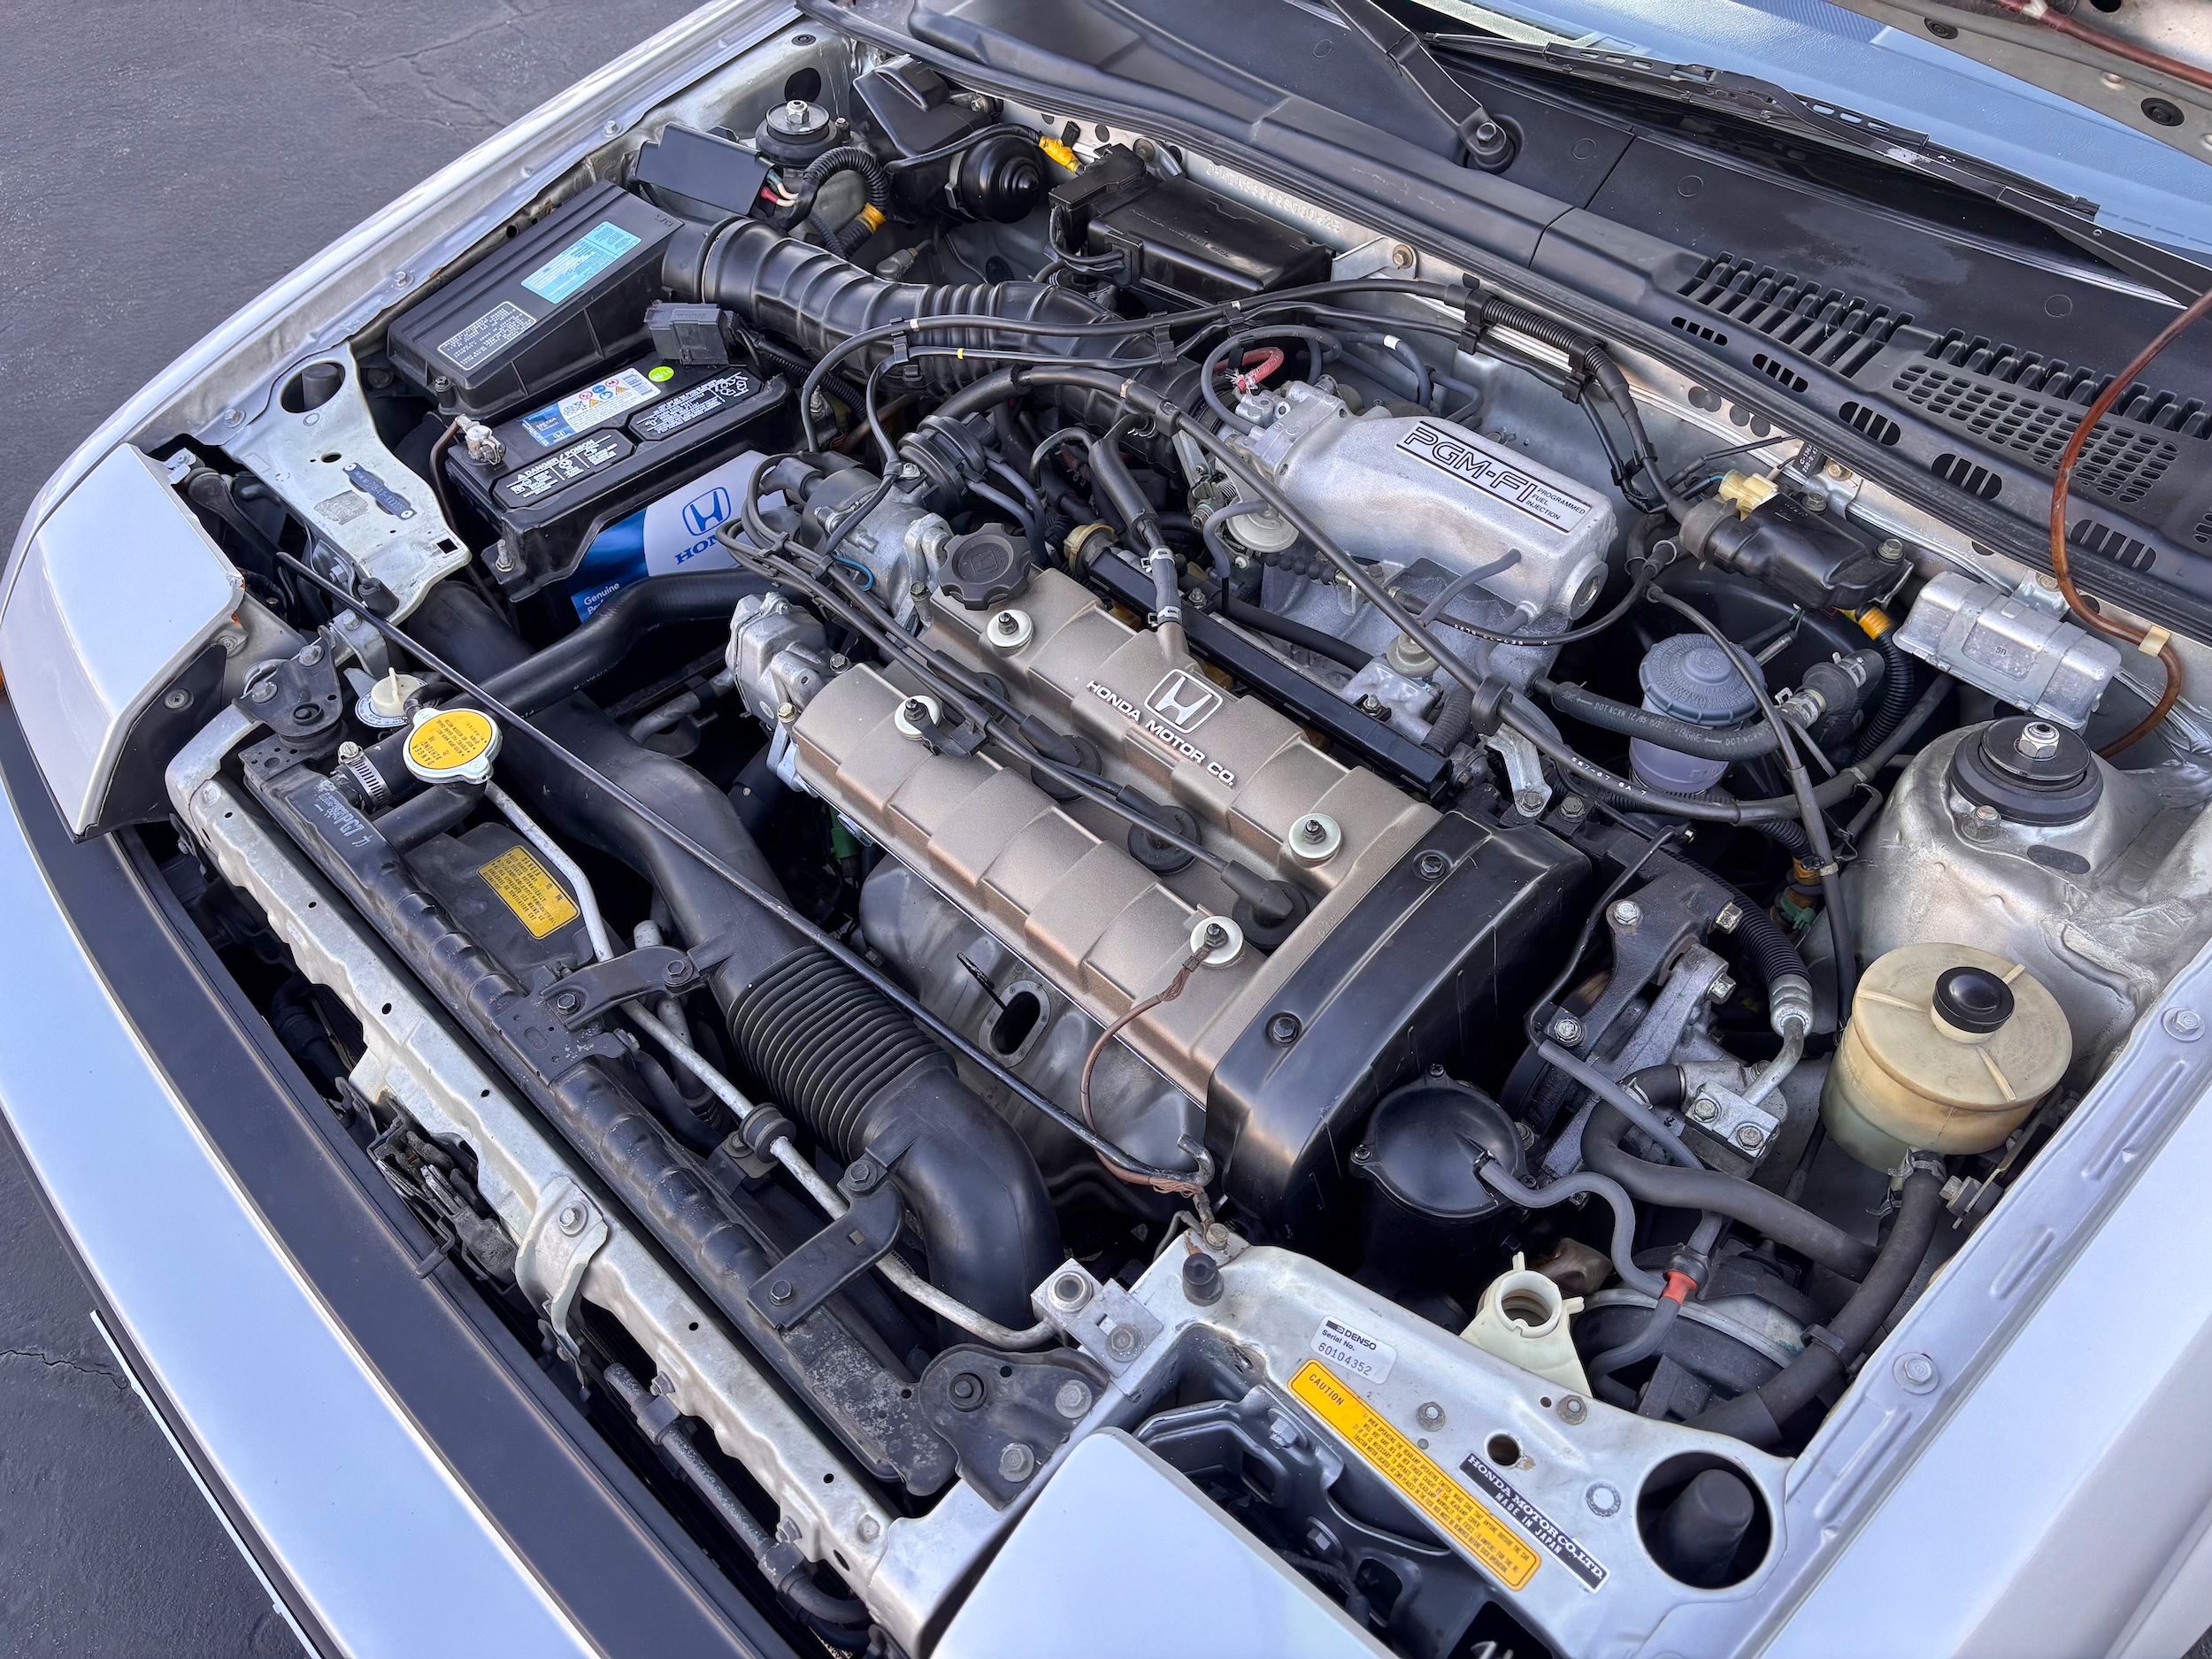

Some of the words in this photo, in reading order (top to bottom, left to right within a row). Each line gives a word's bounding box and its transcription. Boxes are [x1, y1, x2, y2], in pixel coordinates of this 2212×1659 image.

[524, 457, 559, 476] DANGER
[1402, 425, 1539, 503] PGM-FI
[1525, 499, 1562, 520] INJECTION
[1530, 493, 1549, 506] FUEL
[1536, 487, 1586, 515] PROGRAMMED
[671, 534, 720, 565] HON
[583, 580, 620, 606] Genuine
[1594, 701, 1608, 711] DOT
[1085, 678, 1143, 722] HONDA
[1144, 717, 1206, 764] MOTOR
[1205, 759, 1238, 787] CO.
[411, 743, 435, 765] DANGER
[418, 739, 443, 760] ACHTUNG!
[521, 856, 541, 877] DANGER
[1320, 1328, 1342, 1343] Serial
[1342, 1340, 1356, 1351] No.
[1343, 1328, 1378, 1351] DENSO
[1316, 1341, 1373, 1376] 60104352
[1307, 1372, 1346, 1406] CAUTION
[1466, 1454, 1514, 1497] HONDA
[1510, 1493, 1560, 1539] MOTOR
[1494, 1491, 1521, 1517] MADE
[1520, 1515, 1533, 1528] IN
[1532, 1526, 1563, 1555] JAPAN
